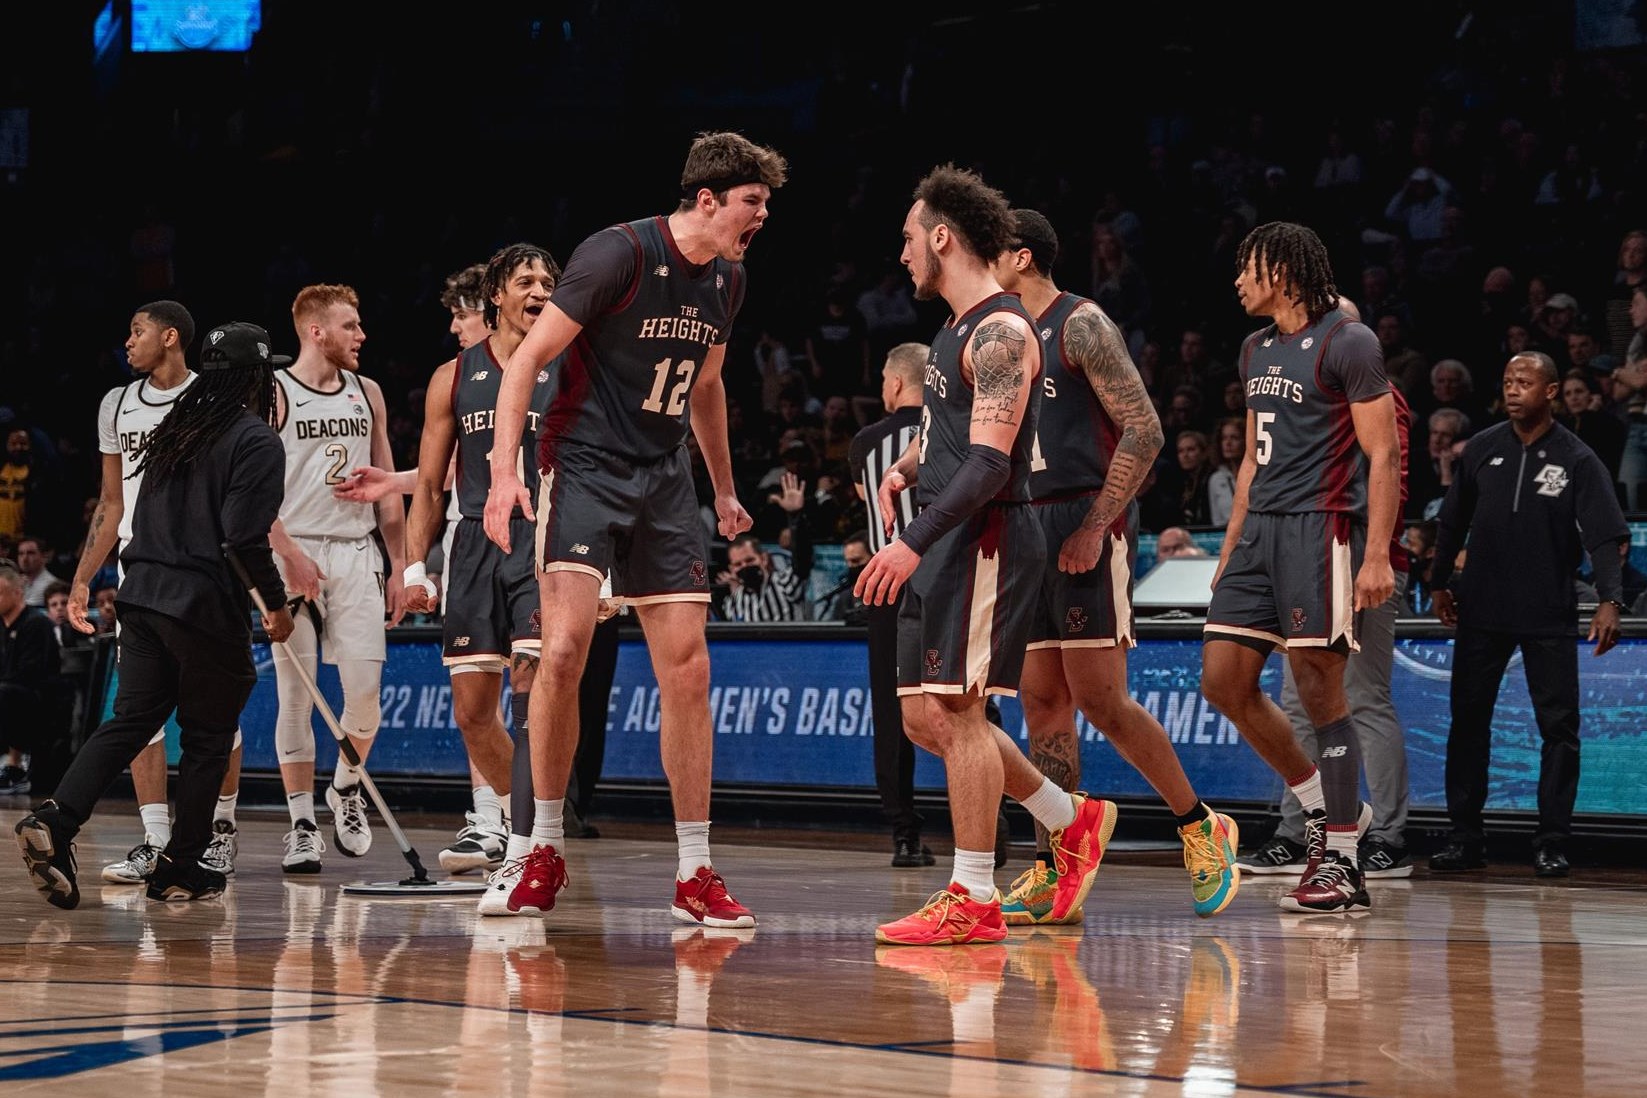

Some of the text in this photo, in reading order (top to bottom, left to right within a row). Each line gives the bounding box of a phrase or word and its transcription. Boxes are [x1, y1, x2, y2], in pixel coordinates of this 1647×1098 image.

[680, 305, 699, 318] THE
[638, 317, 719, 349] HEIGHTS
[641, 357, 696, 416] 12
[1267, 365, 1283, 376] THE
[296, 417, 368, 440] DEACONS
[1256, 412, 1276, 466] 5
[325, 443, 348, 485] 2
[413, 685, 457, 729] NE
[623, 686, 661, 732] AC
